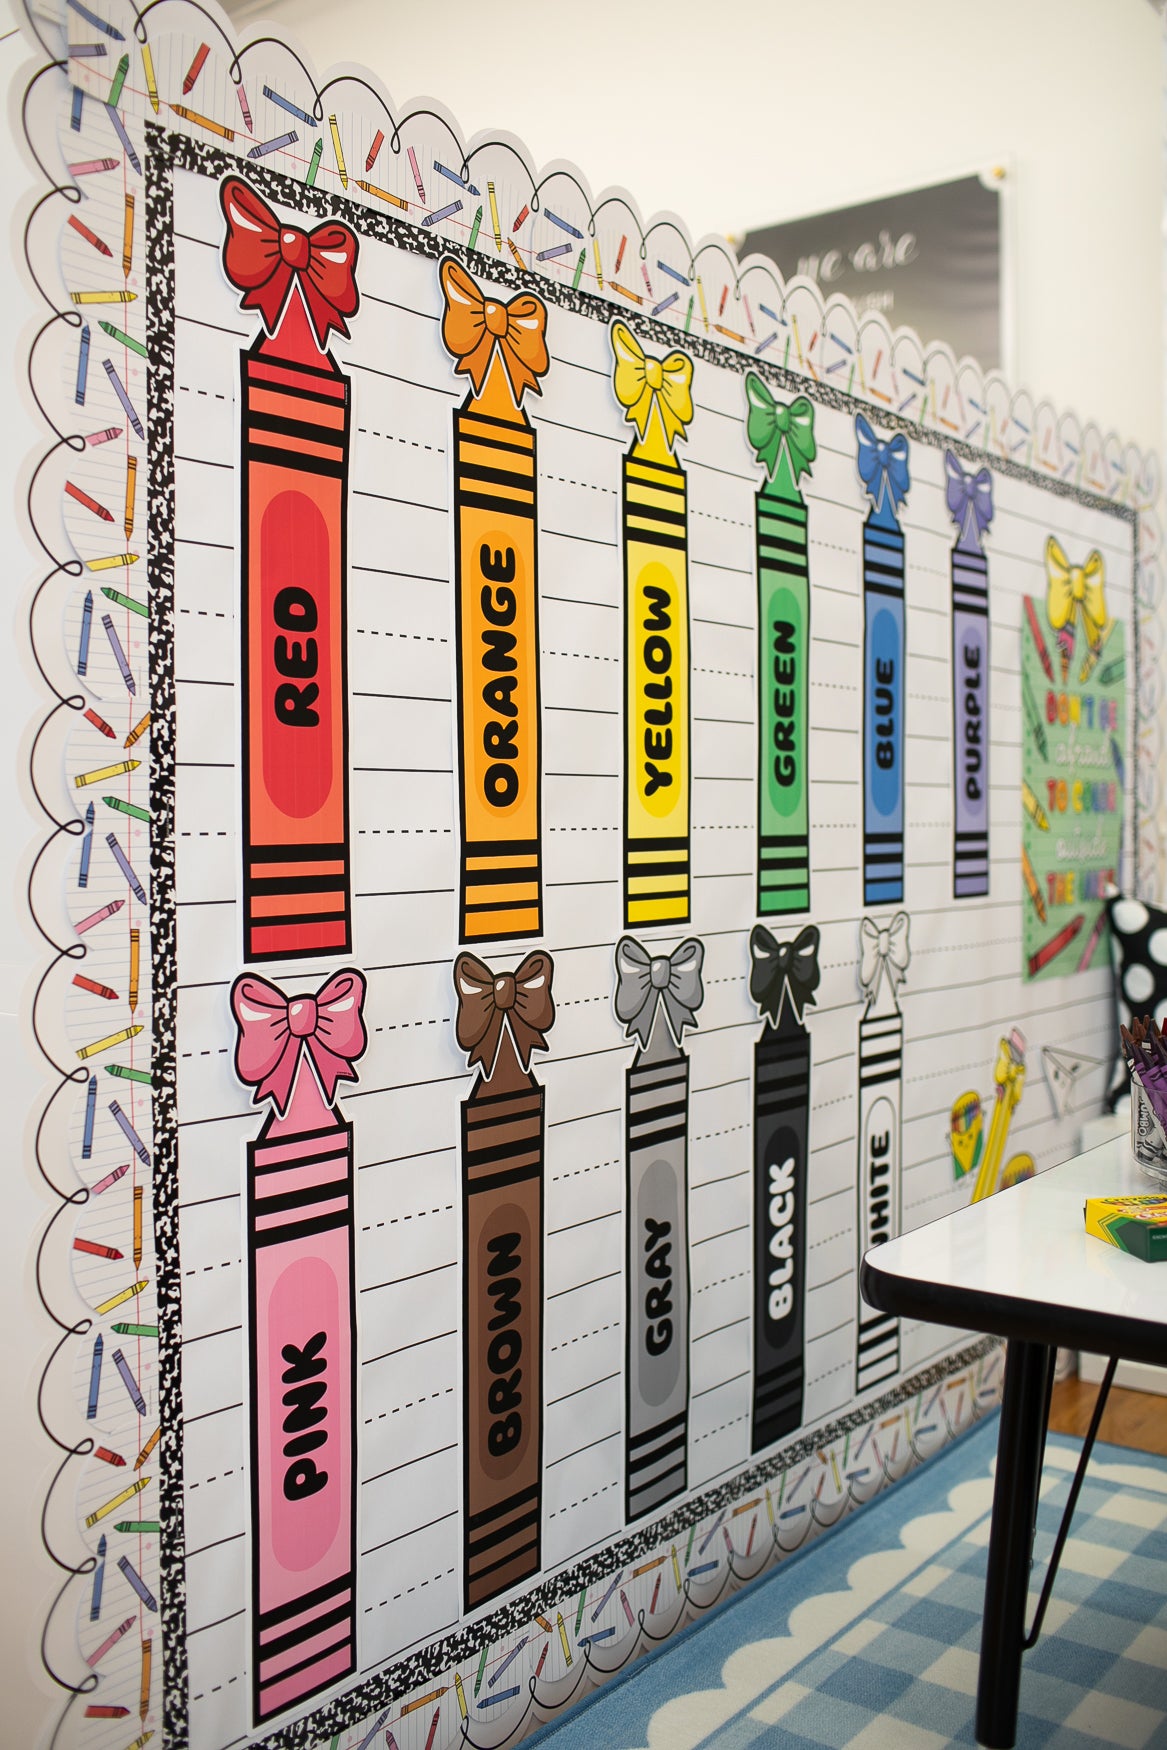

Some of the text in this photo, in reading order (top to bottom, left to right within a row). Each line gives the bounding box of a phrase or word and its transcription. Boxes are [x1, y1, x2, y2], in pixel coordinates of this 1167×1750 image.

[274, 586, 320, 728] RED
[480, 543, 519, 808] ORANGE
[643, 585, 673, 797] YELLOW
[773, 620, 797, 787] GREEN
[875, 657, 895, 770] BLUE
[964, 644, 982, 801] PURPLE
[644, 1217, 674, 1357] GRAY
[768, 1157, 796, 1321] BLACK
[281, 1330, 328, 1502] PINK
[486, 1232, 523, 1458] BROWN
